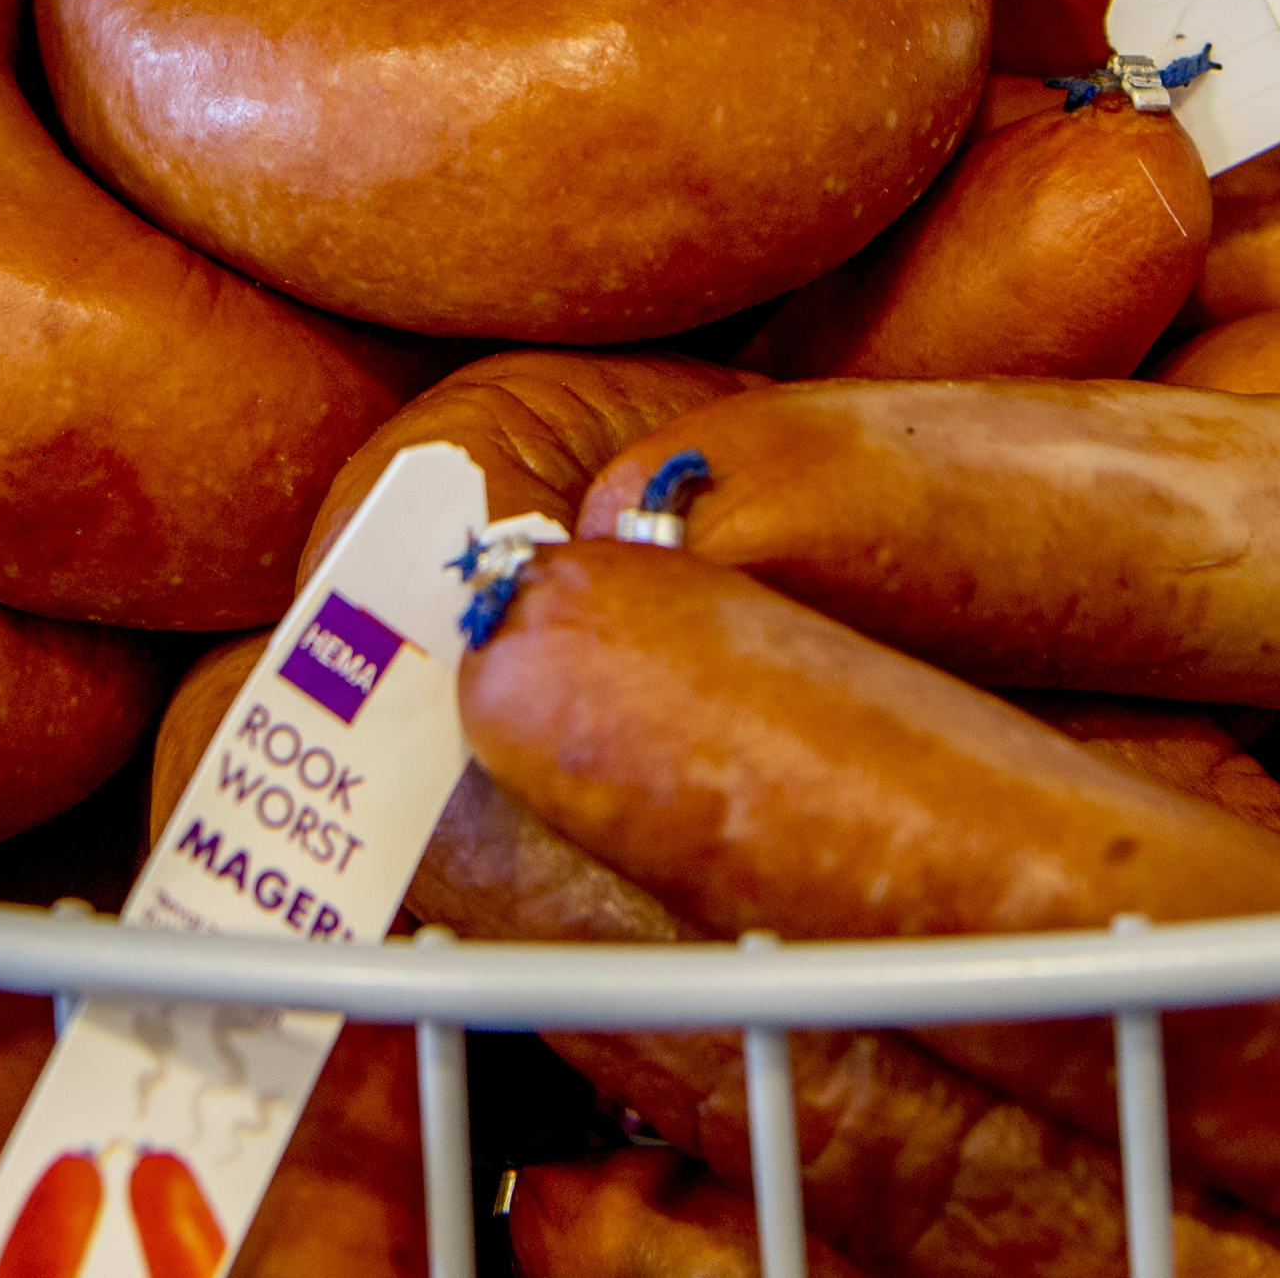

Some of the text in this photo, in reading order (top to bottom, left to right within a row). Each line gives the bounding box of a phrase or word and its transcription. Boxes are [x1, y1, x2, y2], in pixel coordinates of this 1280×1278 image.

[299, 622, 379, 694] HEMA
[217, 751, 364, 874] WORST
[237, 703, 364, 813] ROOK
